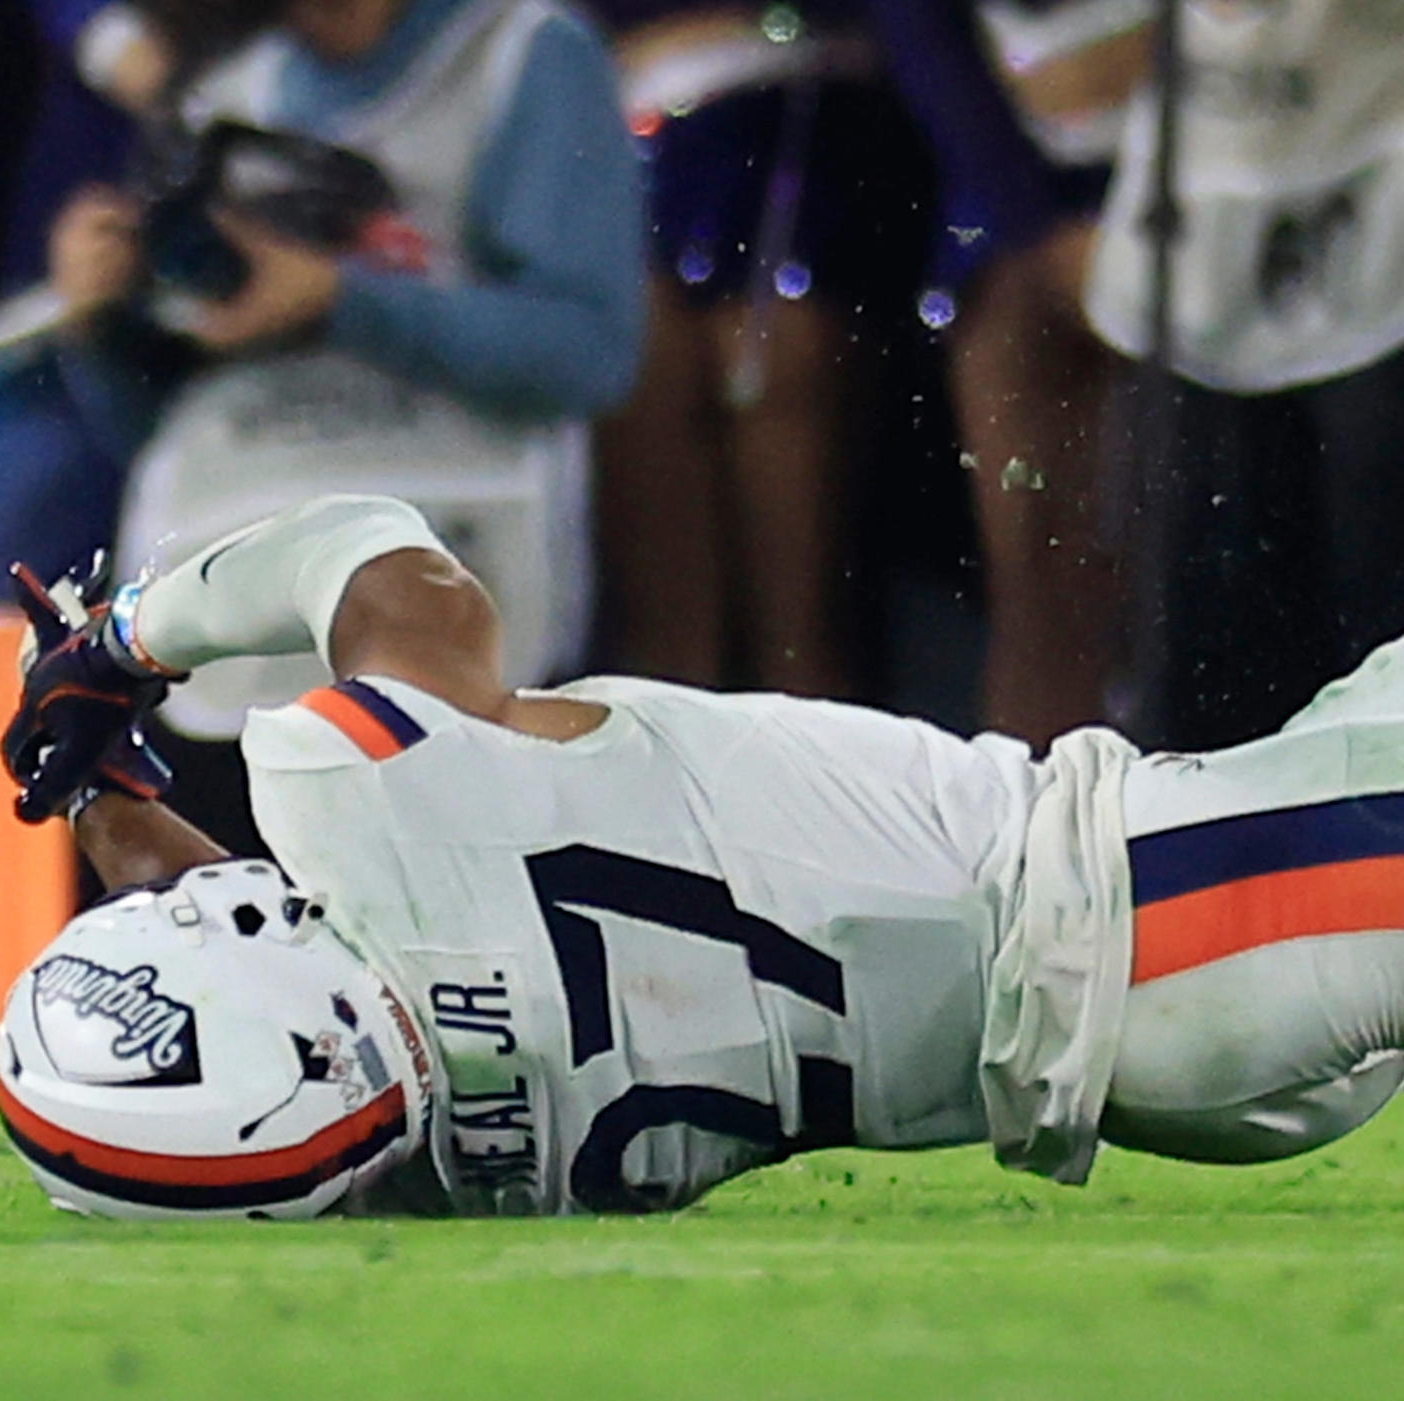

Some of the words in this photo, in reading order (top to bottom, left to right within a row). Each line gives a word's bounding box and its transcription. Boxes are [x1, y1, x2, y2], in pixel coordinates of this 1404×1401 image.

[34, 955, 192, 1072] Virginia
[430, 970, 517, 1056] JR.
[522, 842, 856, 1214] 27
